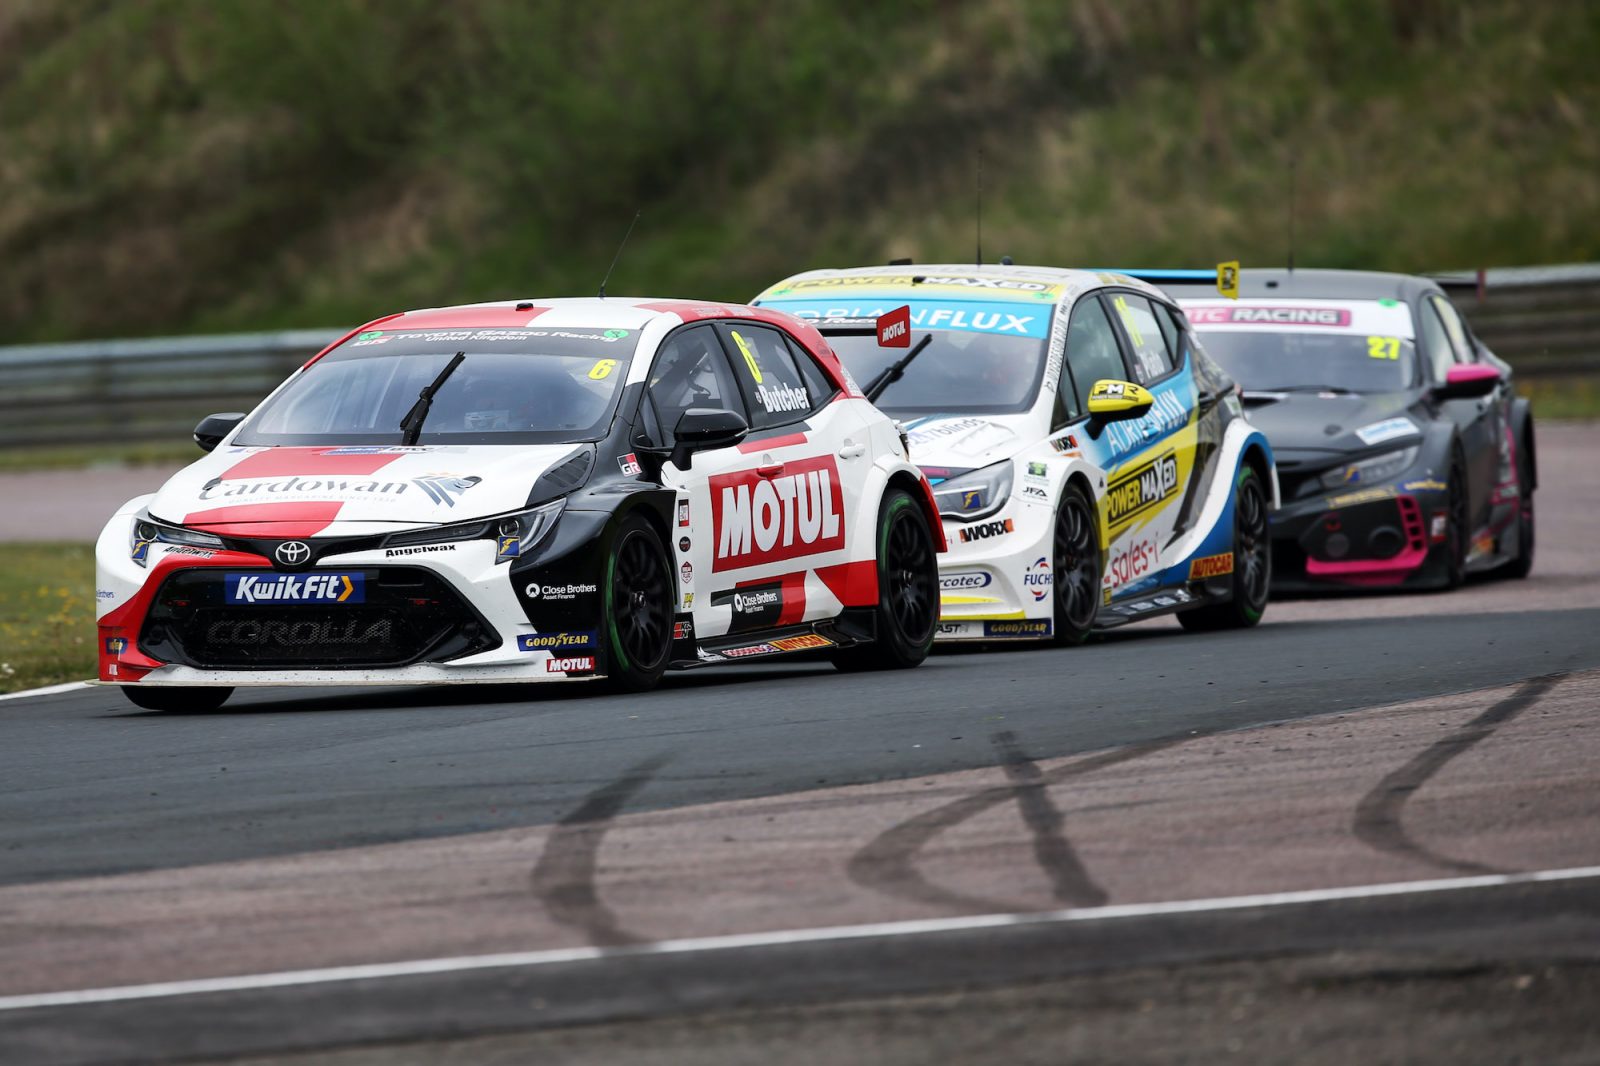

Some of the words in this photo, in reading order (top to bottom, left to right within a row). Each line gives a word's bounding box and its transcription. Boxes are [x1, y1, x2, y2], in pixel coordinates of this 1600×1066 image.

[924, 277, 1047, 291] MAXED
[1232, 309, 1338, 323] RACING
[398, 331, 472, 340] TOYOTA
[551, 331, 619, 342] Racing
[468, 334, 528, 342] Kingdom
[882, 320, 906, 342] MOTUL
[1368, 336, 1400, 360] 27
[588, 359, 616, 379] 6
[761, 382, 811, 413] Butcher
[199, 477, 408, 501] Cardowan
[1023, 486, 1047, 497] JFA
[1107, 479, 1141, 518] POWER
[1141, 458, 1177, 503] MAXED
[718, 469, 841, 560] MOTUL
[963, 520, 1008, 543] WORX
[162, 546, 213, 559] Angelwax
[385, 544, 456, 558] Angelwax
[1111, 531, 1159, 588] sales-i
[1192, 554, 1233, 578] AUTOCAR
[542, 586, 566, 595] Close
[567, 584, 597, 594] Brothers
[940, 576, 982, 587] rcotec
[743, 595, 757, 607] Close
[756, 591, 778, 605] Brothers
[207, 619, 393, 645] COROLLA
[548, 658, 592, 672] MOTUL
